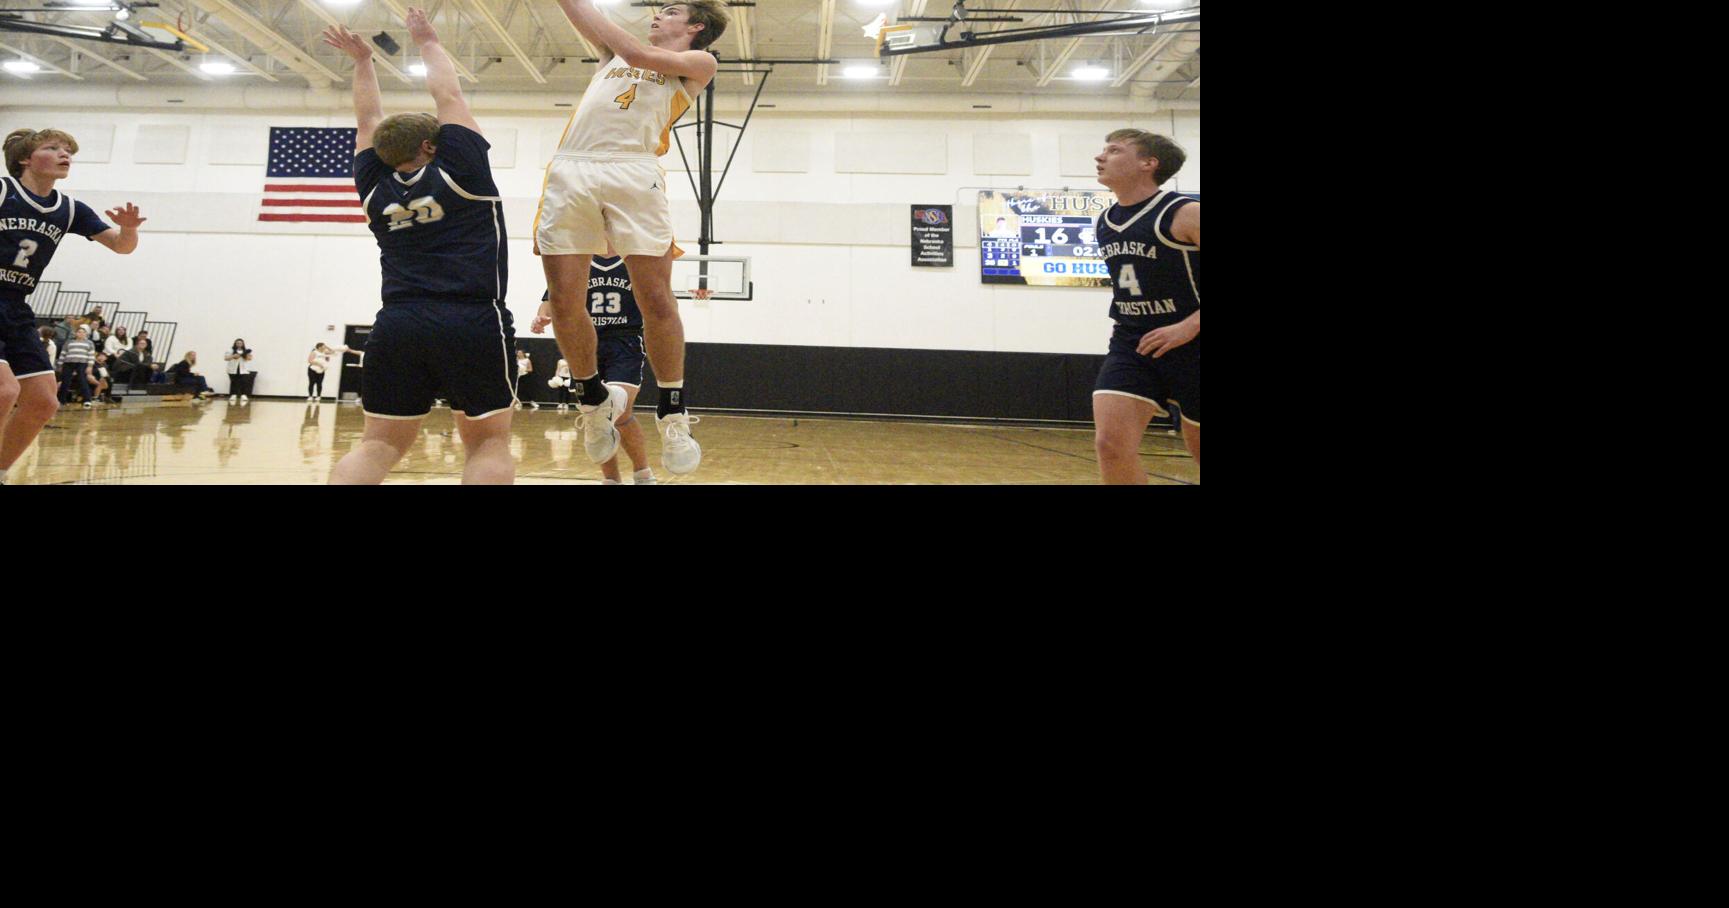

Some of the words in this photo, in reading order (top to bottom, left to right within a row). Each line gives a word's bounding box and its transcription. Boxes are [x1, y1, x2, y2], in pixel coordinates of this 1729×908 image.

[613, 83, 638, 110] 4
[1022, 215, 1063, 224] HUSKIES
[1034, 227, 1069, 244] 16
[13, 238, 38, 268] 2
[1030, 249, 1039, 257] 1
[1100, 240, 1158, 260] EBRASKA
[1043, 262, 1067, 273] GO
[588, 276, 632, 291] EBRASKA
[1117, 263, 1142, 296] 4
[591, 291, 621, 314] 23
